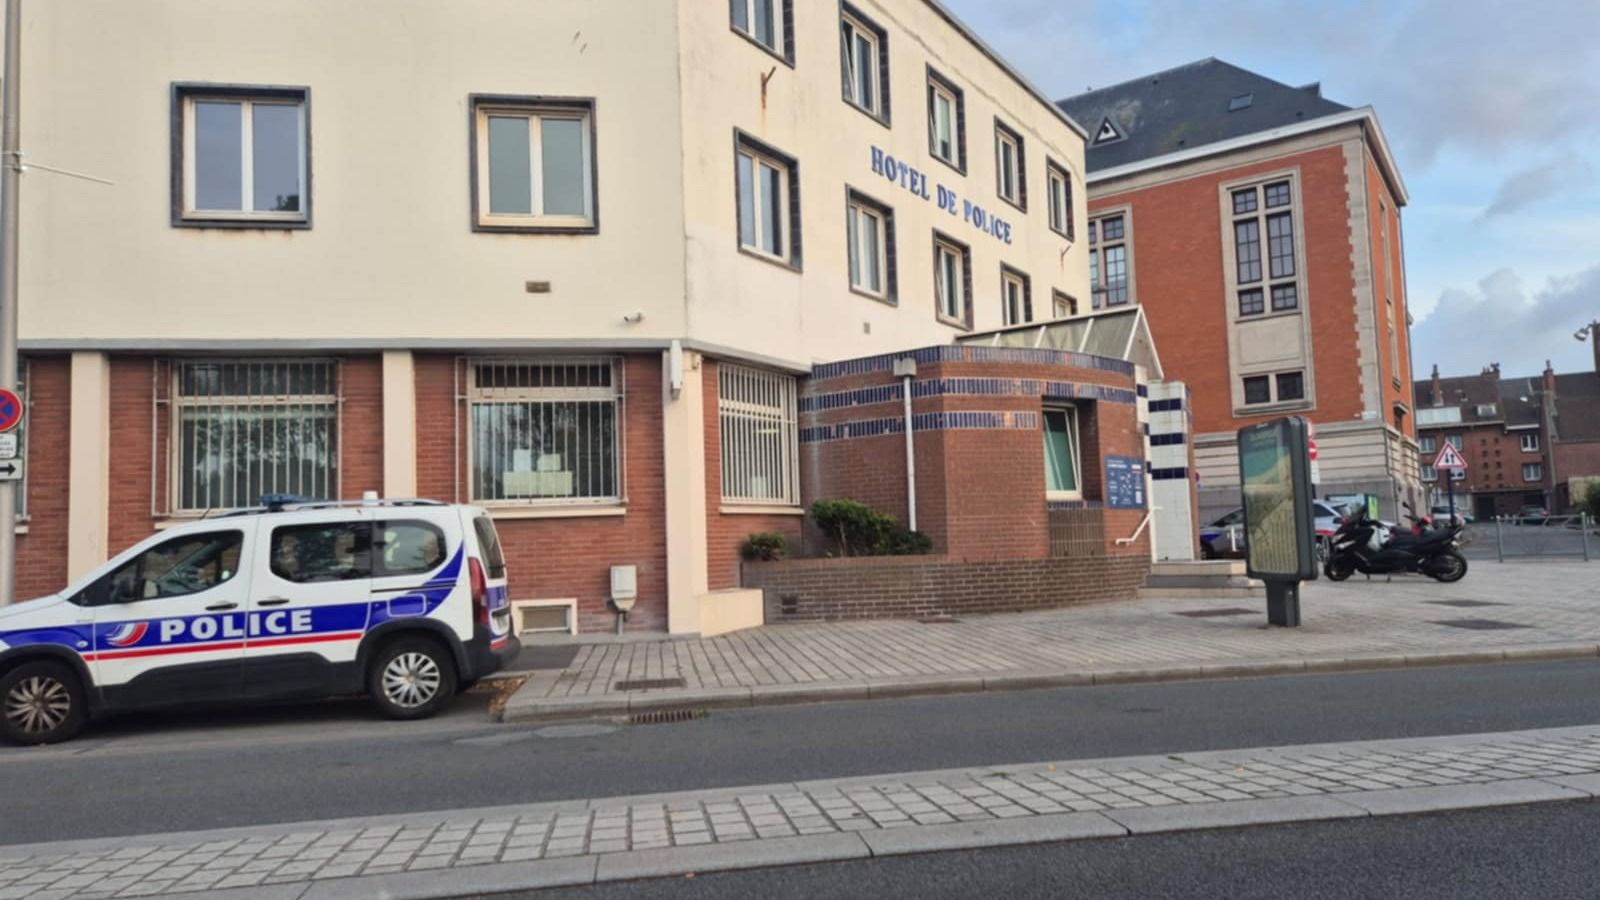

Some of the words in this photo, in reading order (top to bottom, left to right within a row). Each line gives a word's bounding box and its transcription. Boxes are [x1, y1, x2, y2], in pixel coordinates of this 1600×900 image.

[871, 145, 930, 201] HOTEL
[937, 184, 957, 216] DE
[963, 199, 1012, 245] POLICE
[160, 609, 313, 643] POLICE
